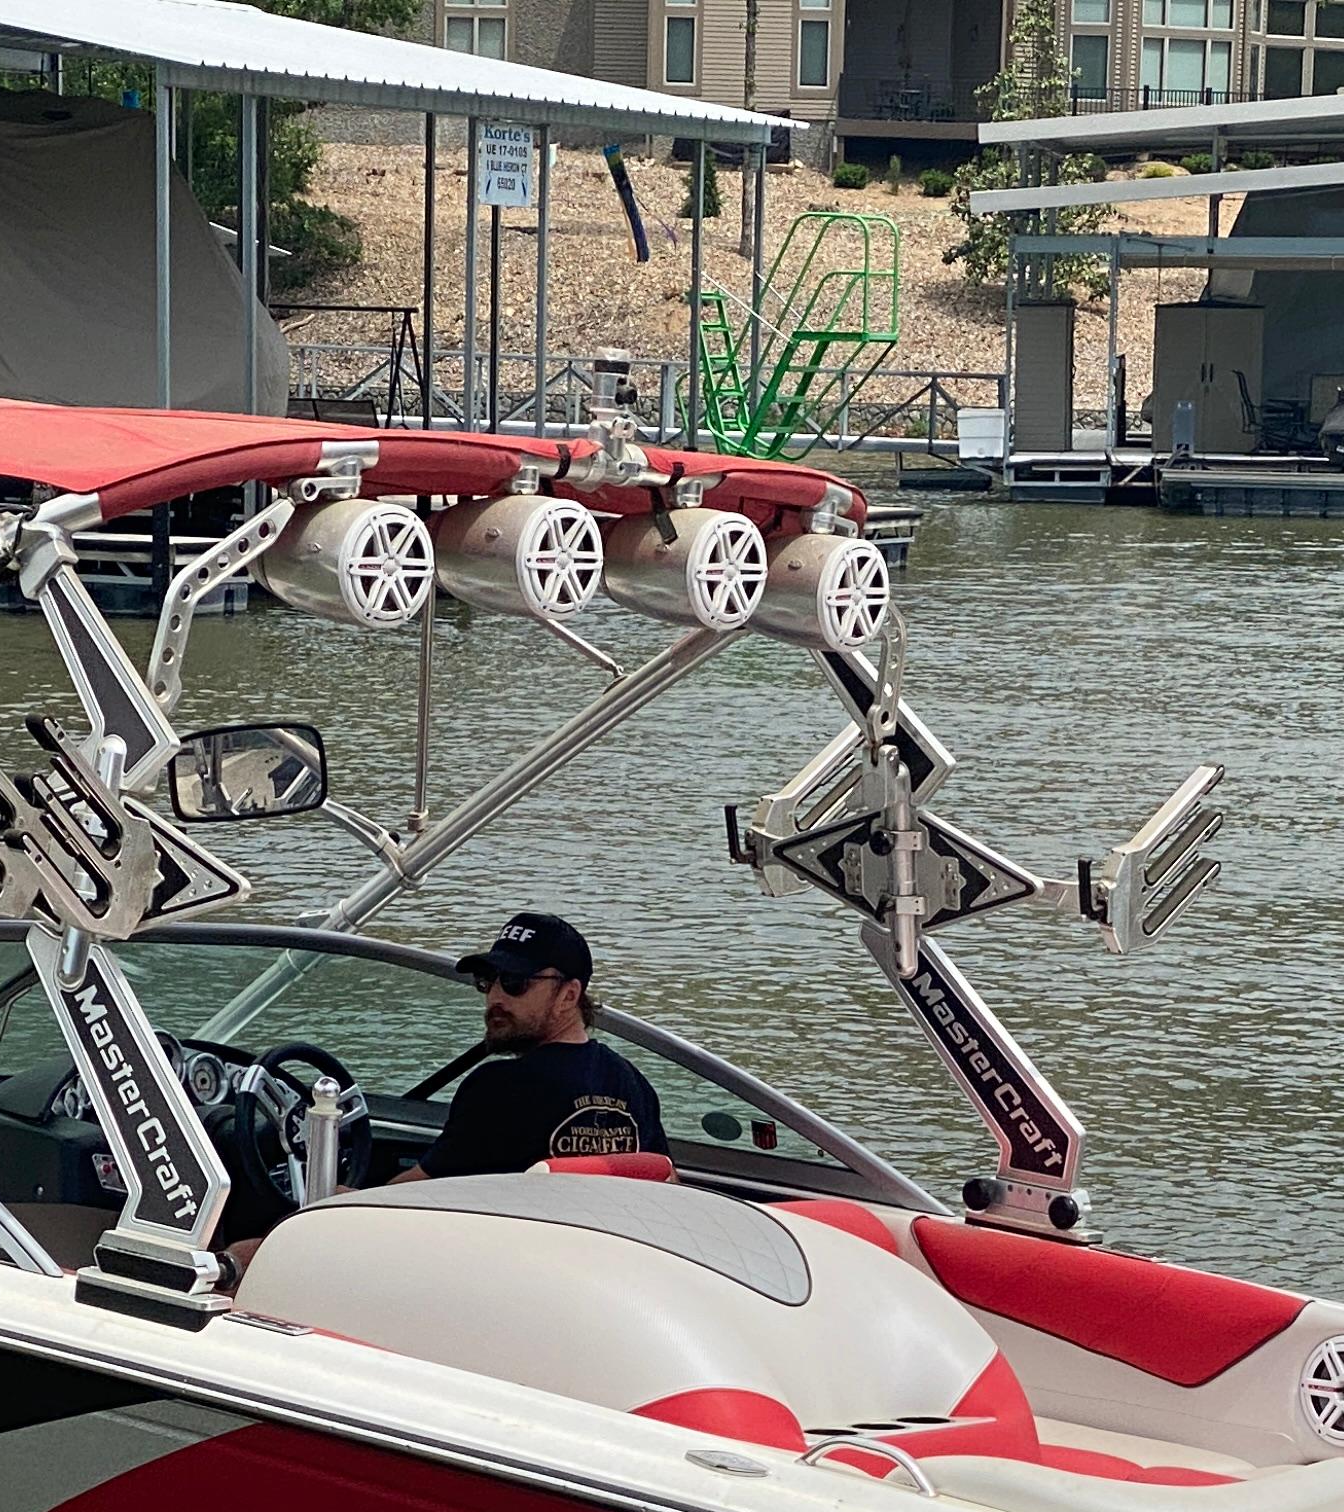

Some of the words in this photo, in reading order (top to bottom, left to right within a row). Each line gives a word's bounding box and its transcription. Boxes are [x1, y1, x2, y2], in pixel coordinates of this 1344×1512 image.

[484, 125, 530, 143] Korte's
[486, 144, 497, 155] UE
[73, 984, 196, 1220] MasterCraft
[911, 971, 1063, 1168] MasterCraft
